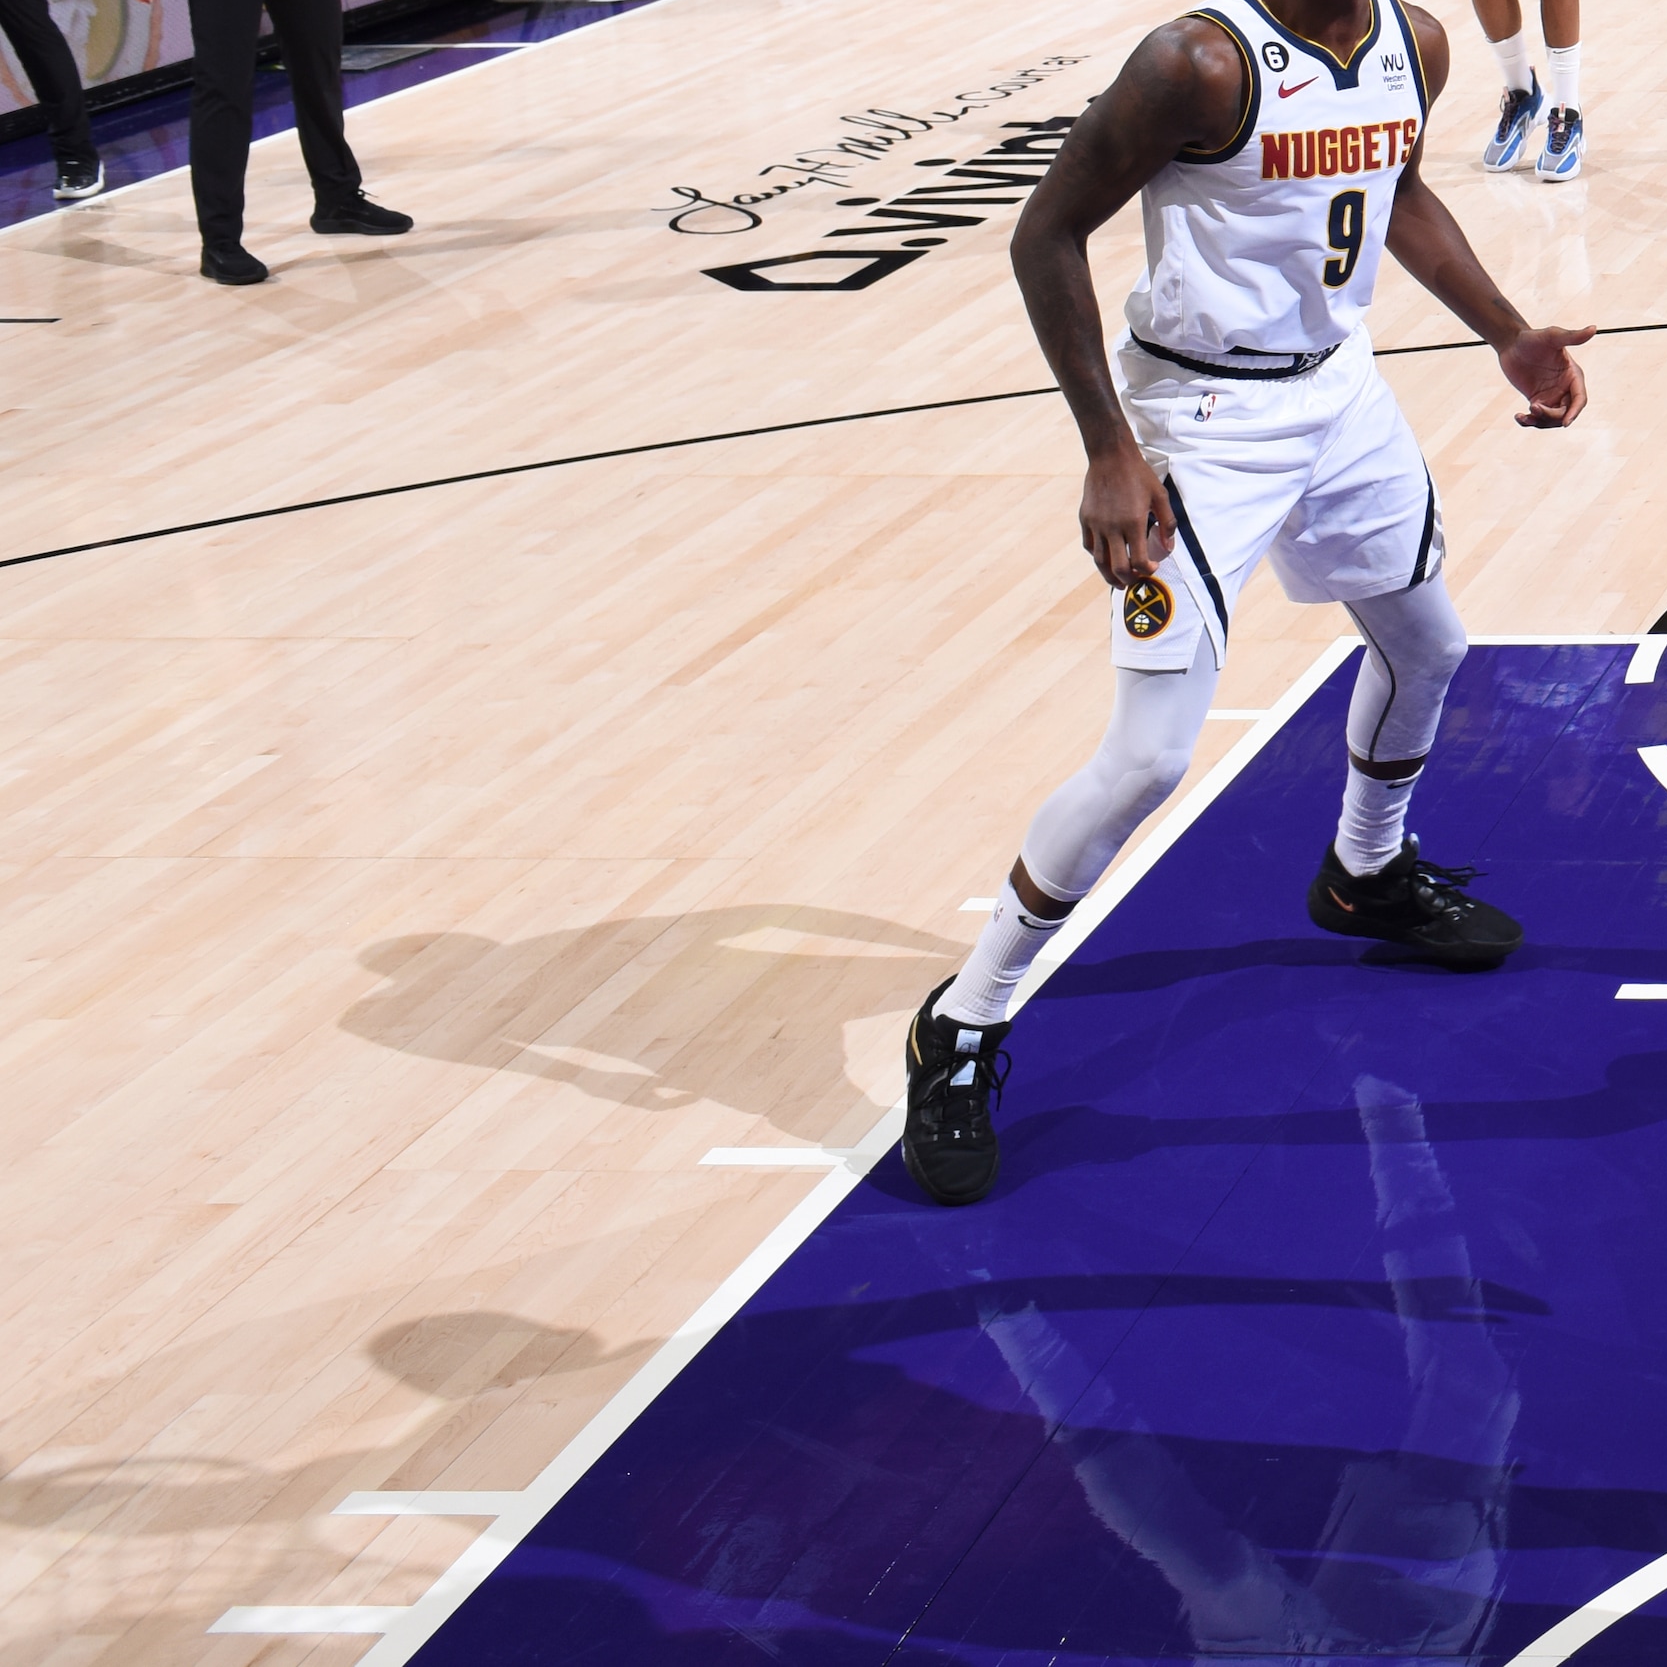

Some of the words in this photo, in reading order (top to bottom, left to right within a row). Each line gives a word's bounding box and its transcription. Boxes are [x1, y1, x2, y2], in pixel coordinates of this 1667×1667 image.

[1264, 44, 1286, 70] 6
[1380, 53, 1405, 73] WU
[1382, 74, 1407, 83] Western
[1387, 82, 1405, 92] Union
[1260, 117, 1417, 181] NUGGETS
[1322, 187, 1368, 290] 9
